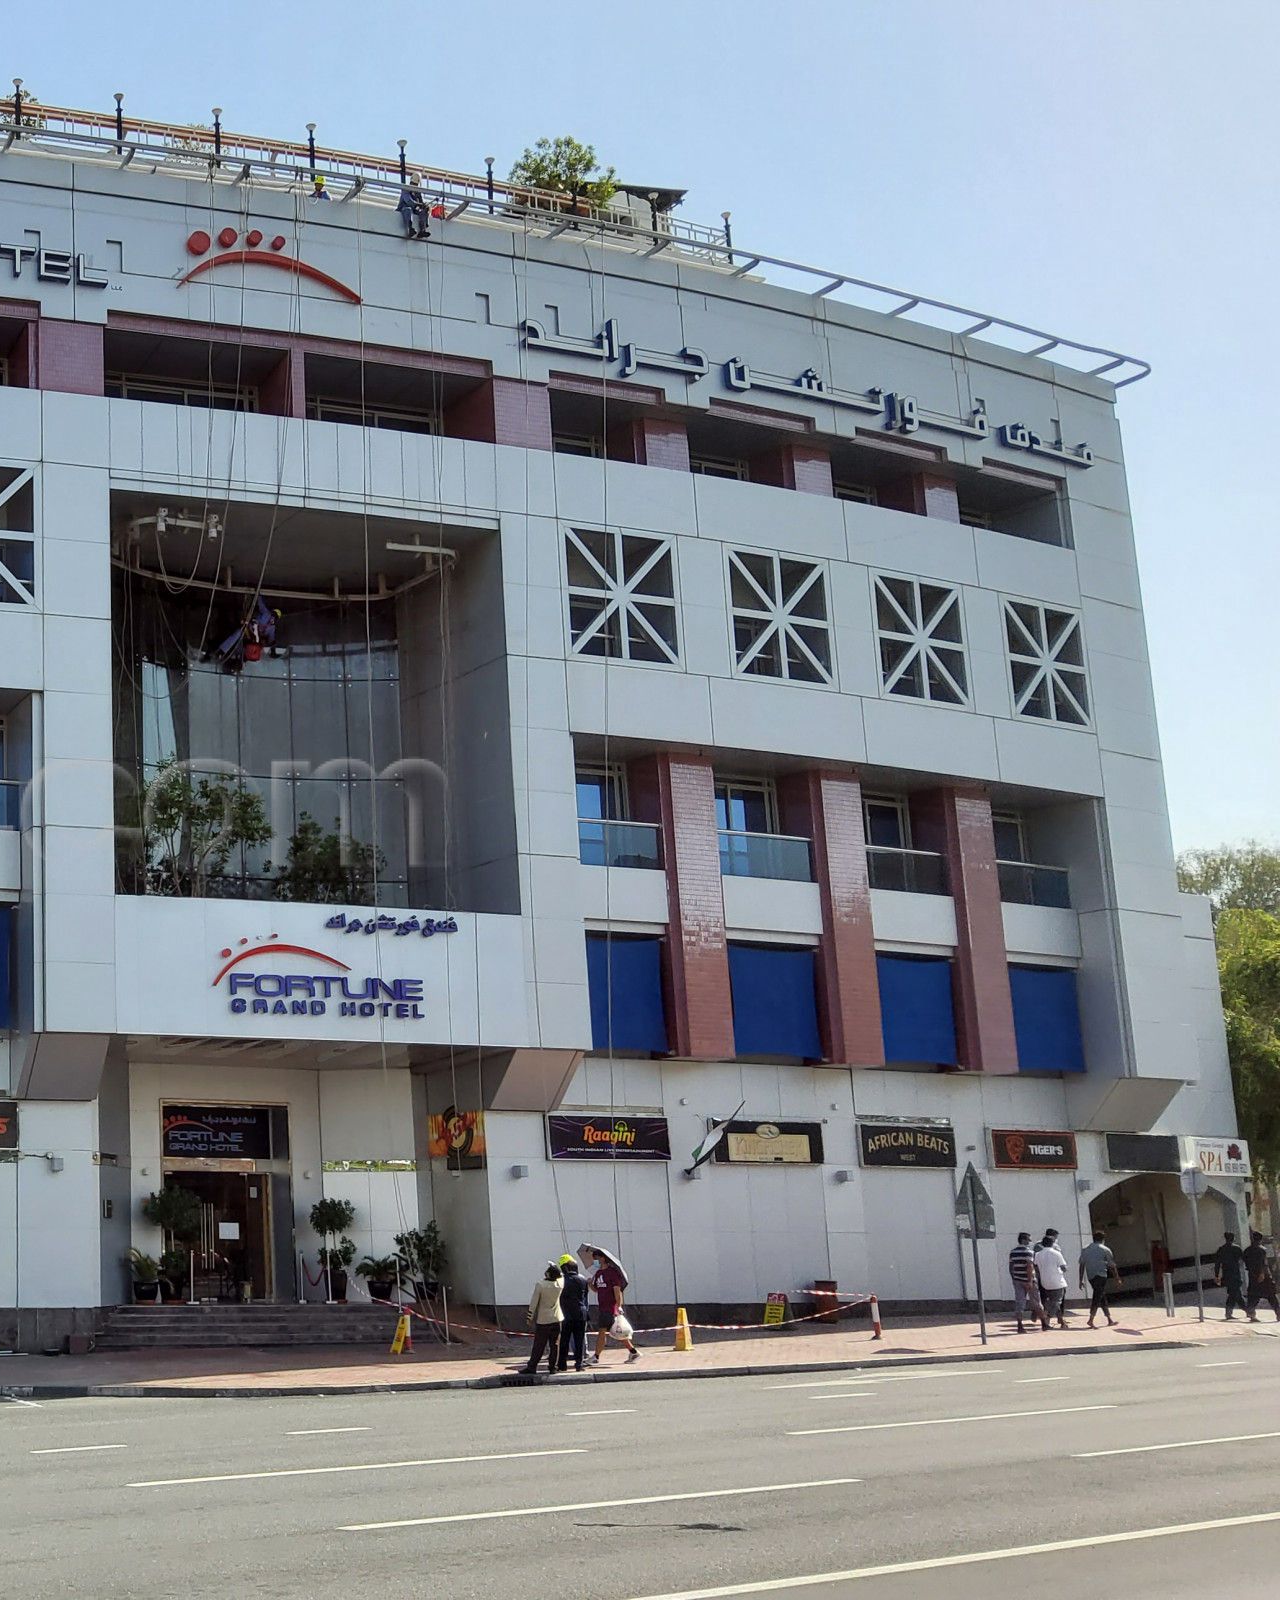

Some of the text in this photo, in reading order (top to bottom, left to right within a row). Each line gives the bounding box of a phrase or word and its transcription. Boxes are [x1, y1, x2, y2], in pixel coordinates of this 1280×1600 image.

[230, 973, 424, 1001] FORTUNE
[231, 998, 425, 1019] GRAND HOTEL
[169, 1130, 243, 1142] FORTUNE
[583, 1125, 636, 1145] Raagini
[868, 1132, 950, 1155] AFRICAN BEATS
[169, 1142, 208, 1151] GRAND
[1029, 1145, 1064, 1156] TIGER'S
[1200, 1151, 1223, 1172] SPA
